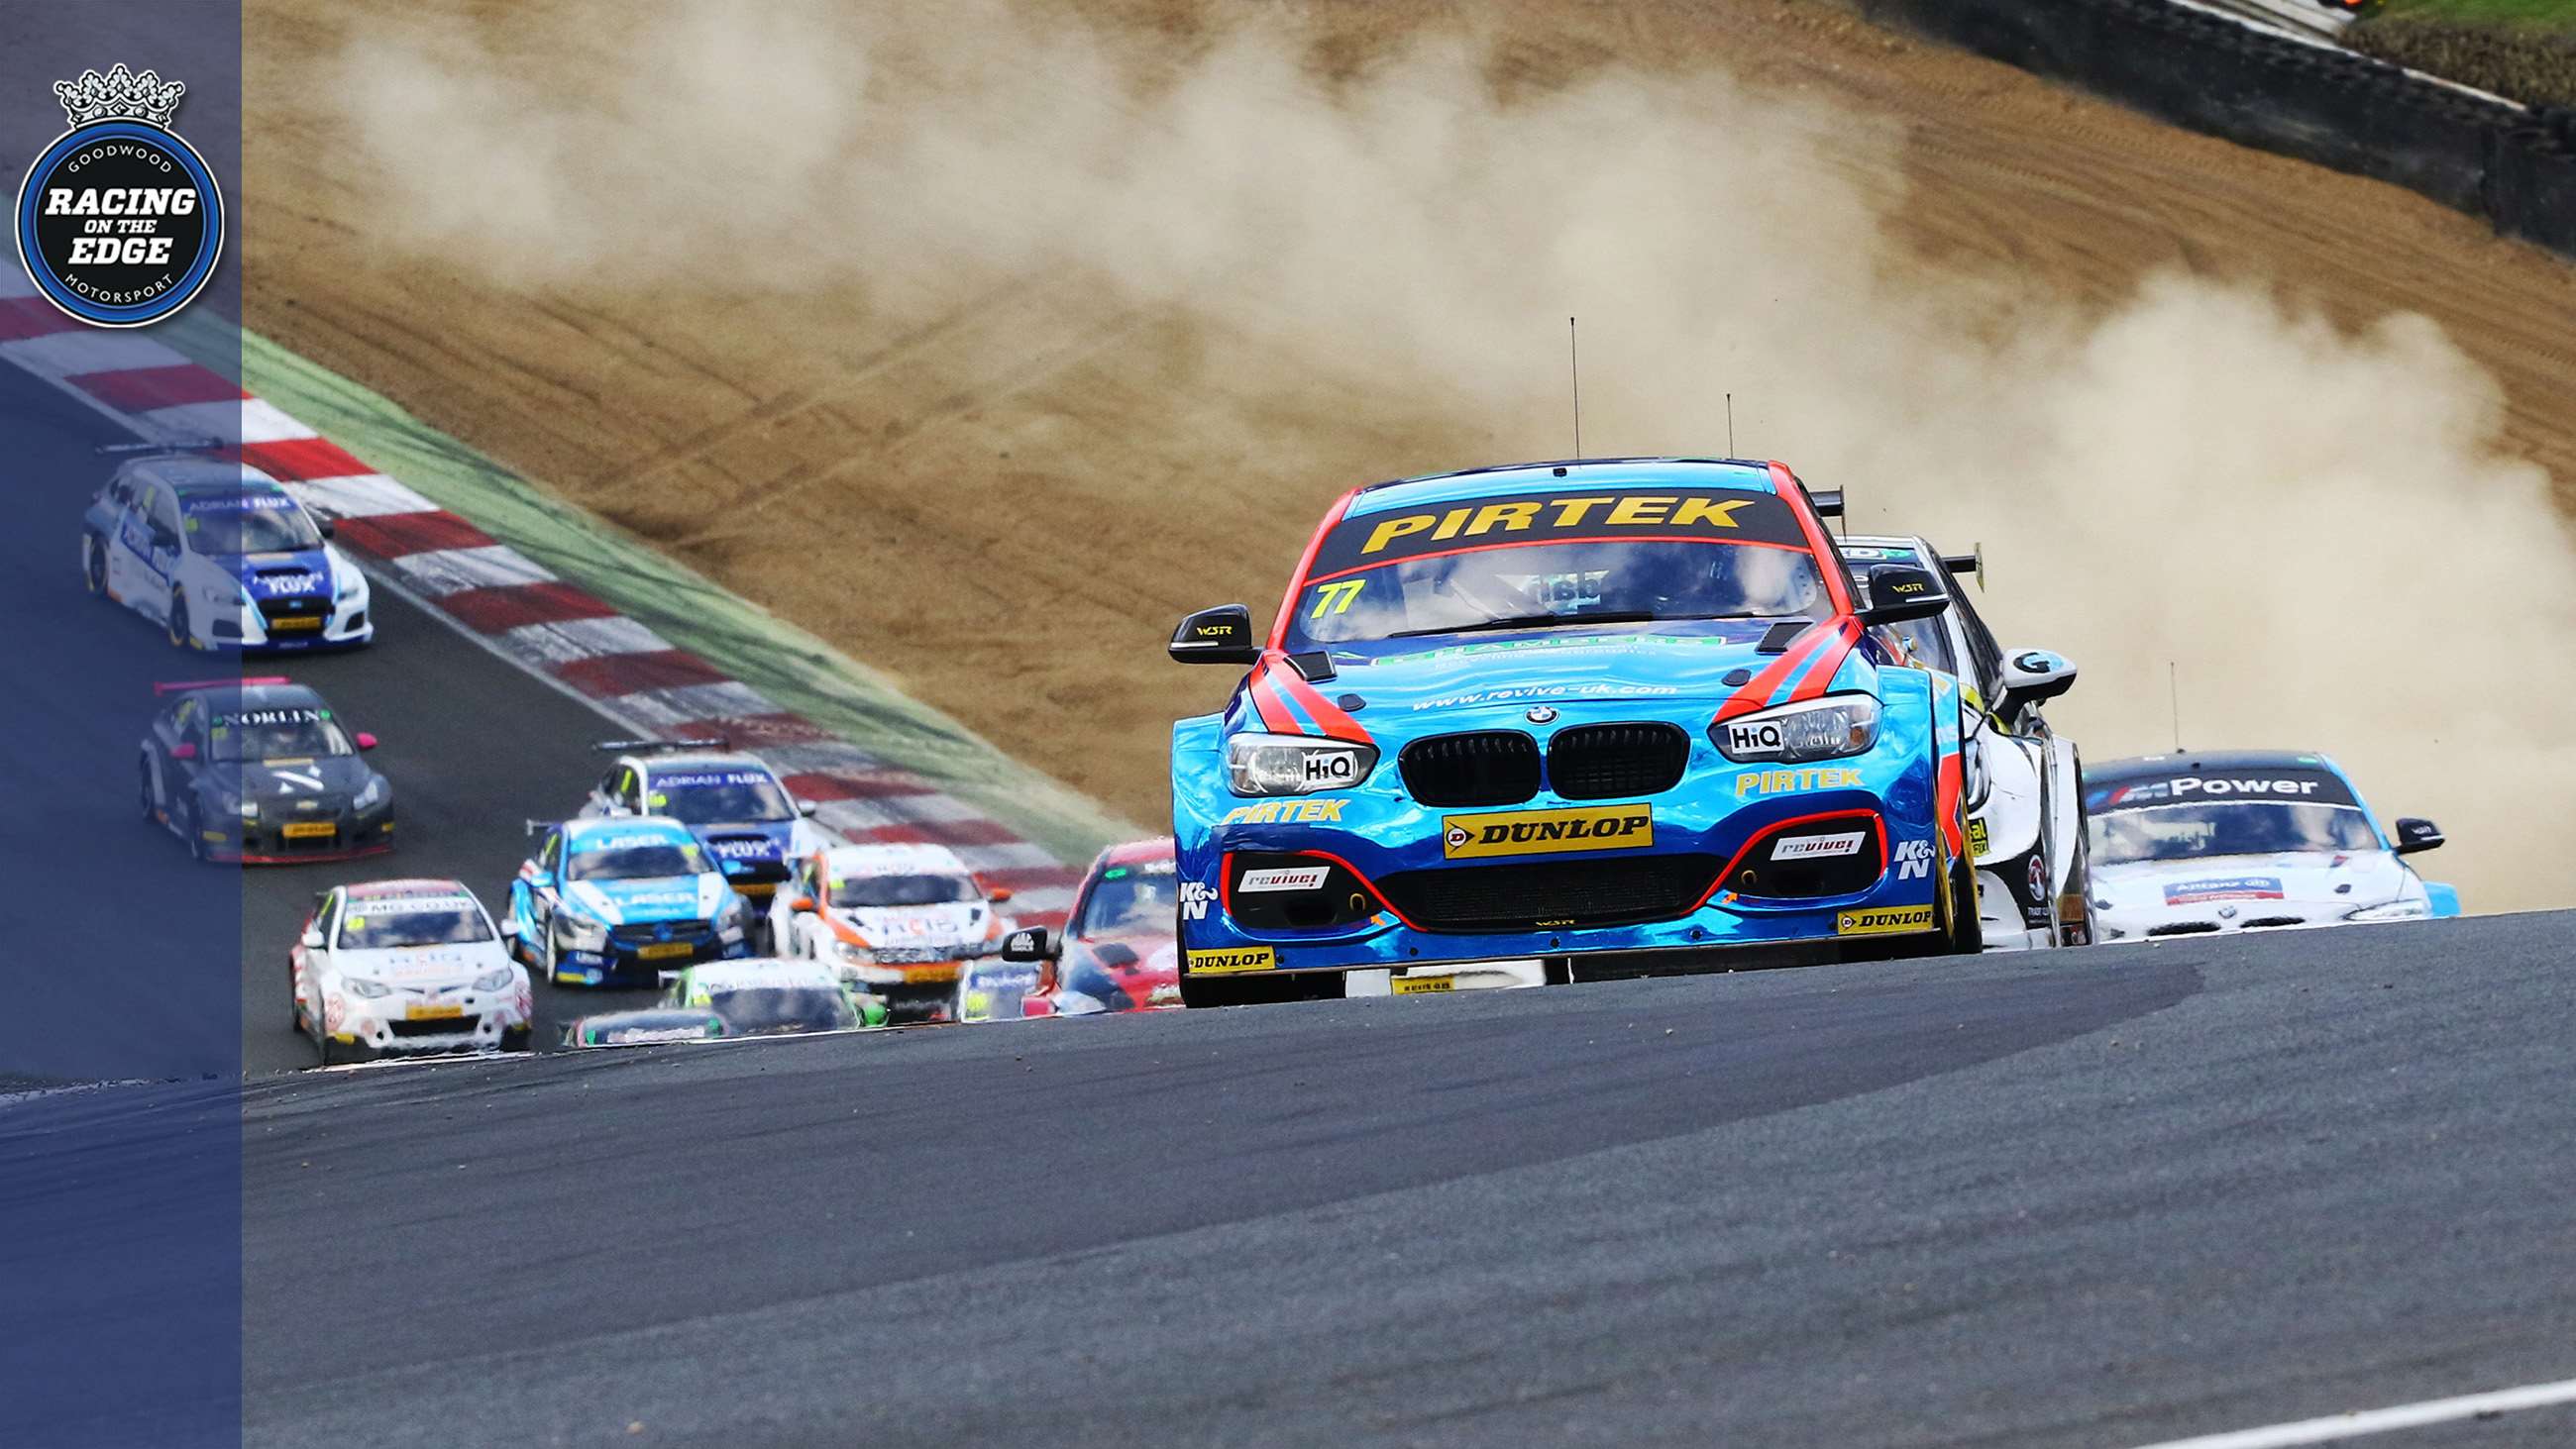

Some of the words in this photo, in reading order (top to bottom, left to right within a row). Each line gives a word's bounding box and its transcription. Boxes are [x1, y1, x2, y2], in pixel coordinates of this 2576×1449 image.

[1361, 496, 1755, 555] PIRTEK
[1310, 578, 1366, 620] 77
[1412, 683, 1678, 712] www.revive-uk.com
[1731, 725, 1781, 749] HiQ
[1305, 756, 1350, 781] HiQ
[1736, 768, 1866, 797] PIRTEK
[2170, 776, 2318, 796] Power
[1221, 798, 1351, 825] PIRTEK
[1478, 815, 1650, 845] DUNLOP
[1859, 911, 1931, 927] DUNLOP
[1194, 953, 1270, 969] DUNLOP
